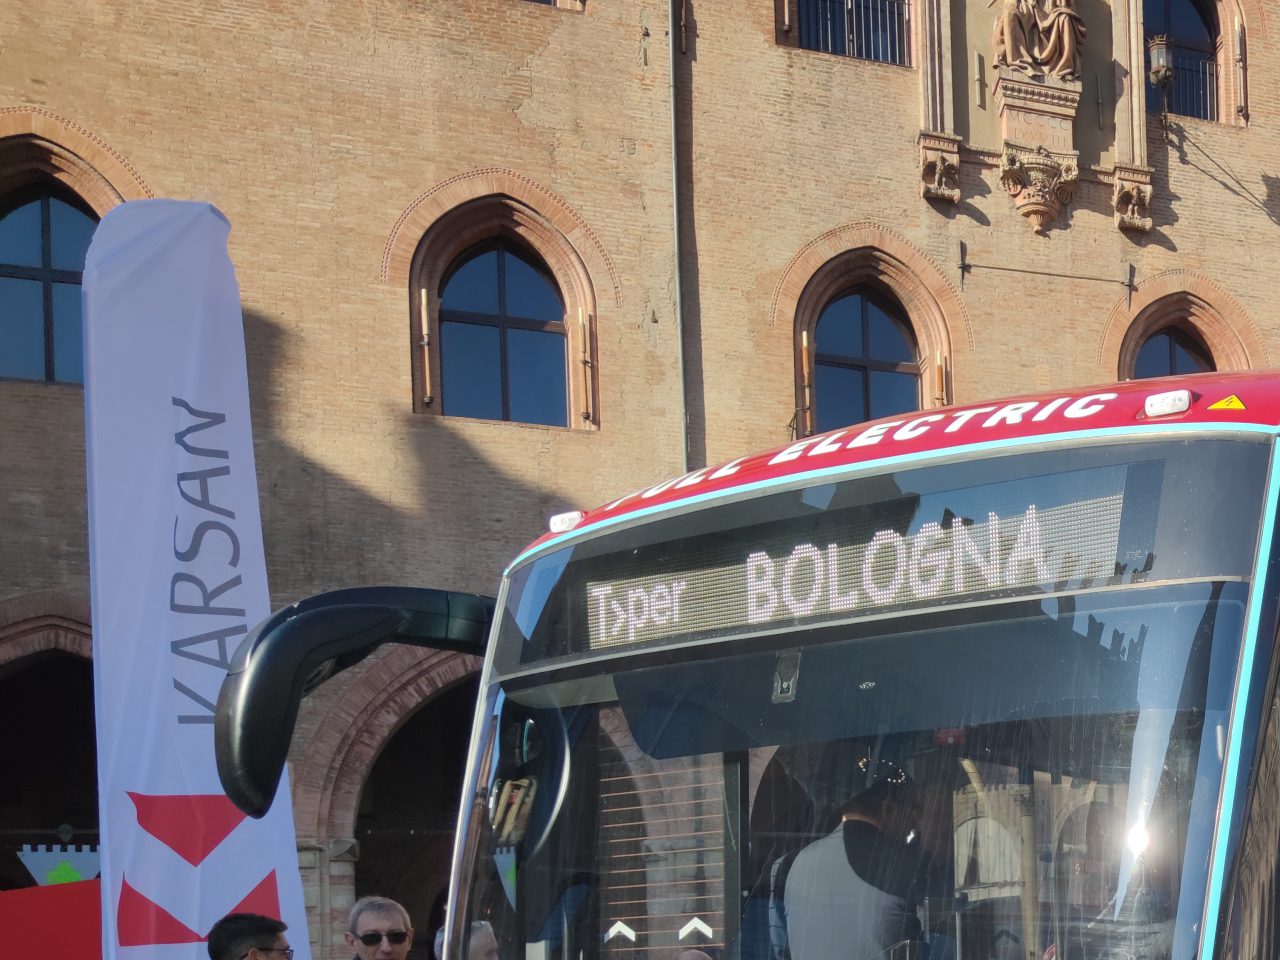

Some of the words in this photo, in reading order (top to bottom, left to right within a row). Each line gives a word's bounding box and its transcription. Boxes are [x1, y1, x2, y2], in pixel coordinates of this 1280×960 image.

[768, 392, 1120, 467] ELECTRIC
[170, 396, 249, 725] KARSAN
[746, 503, 1050, 624] BOLOGNA
